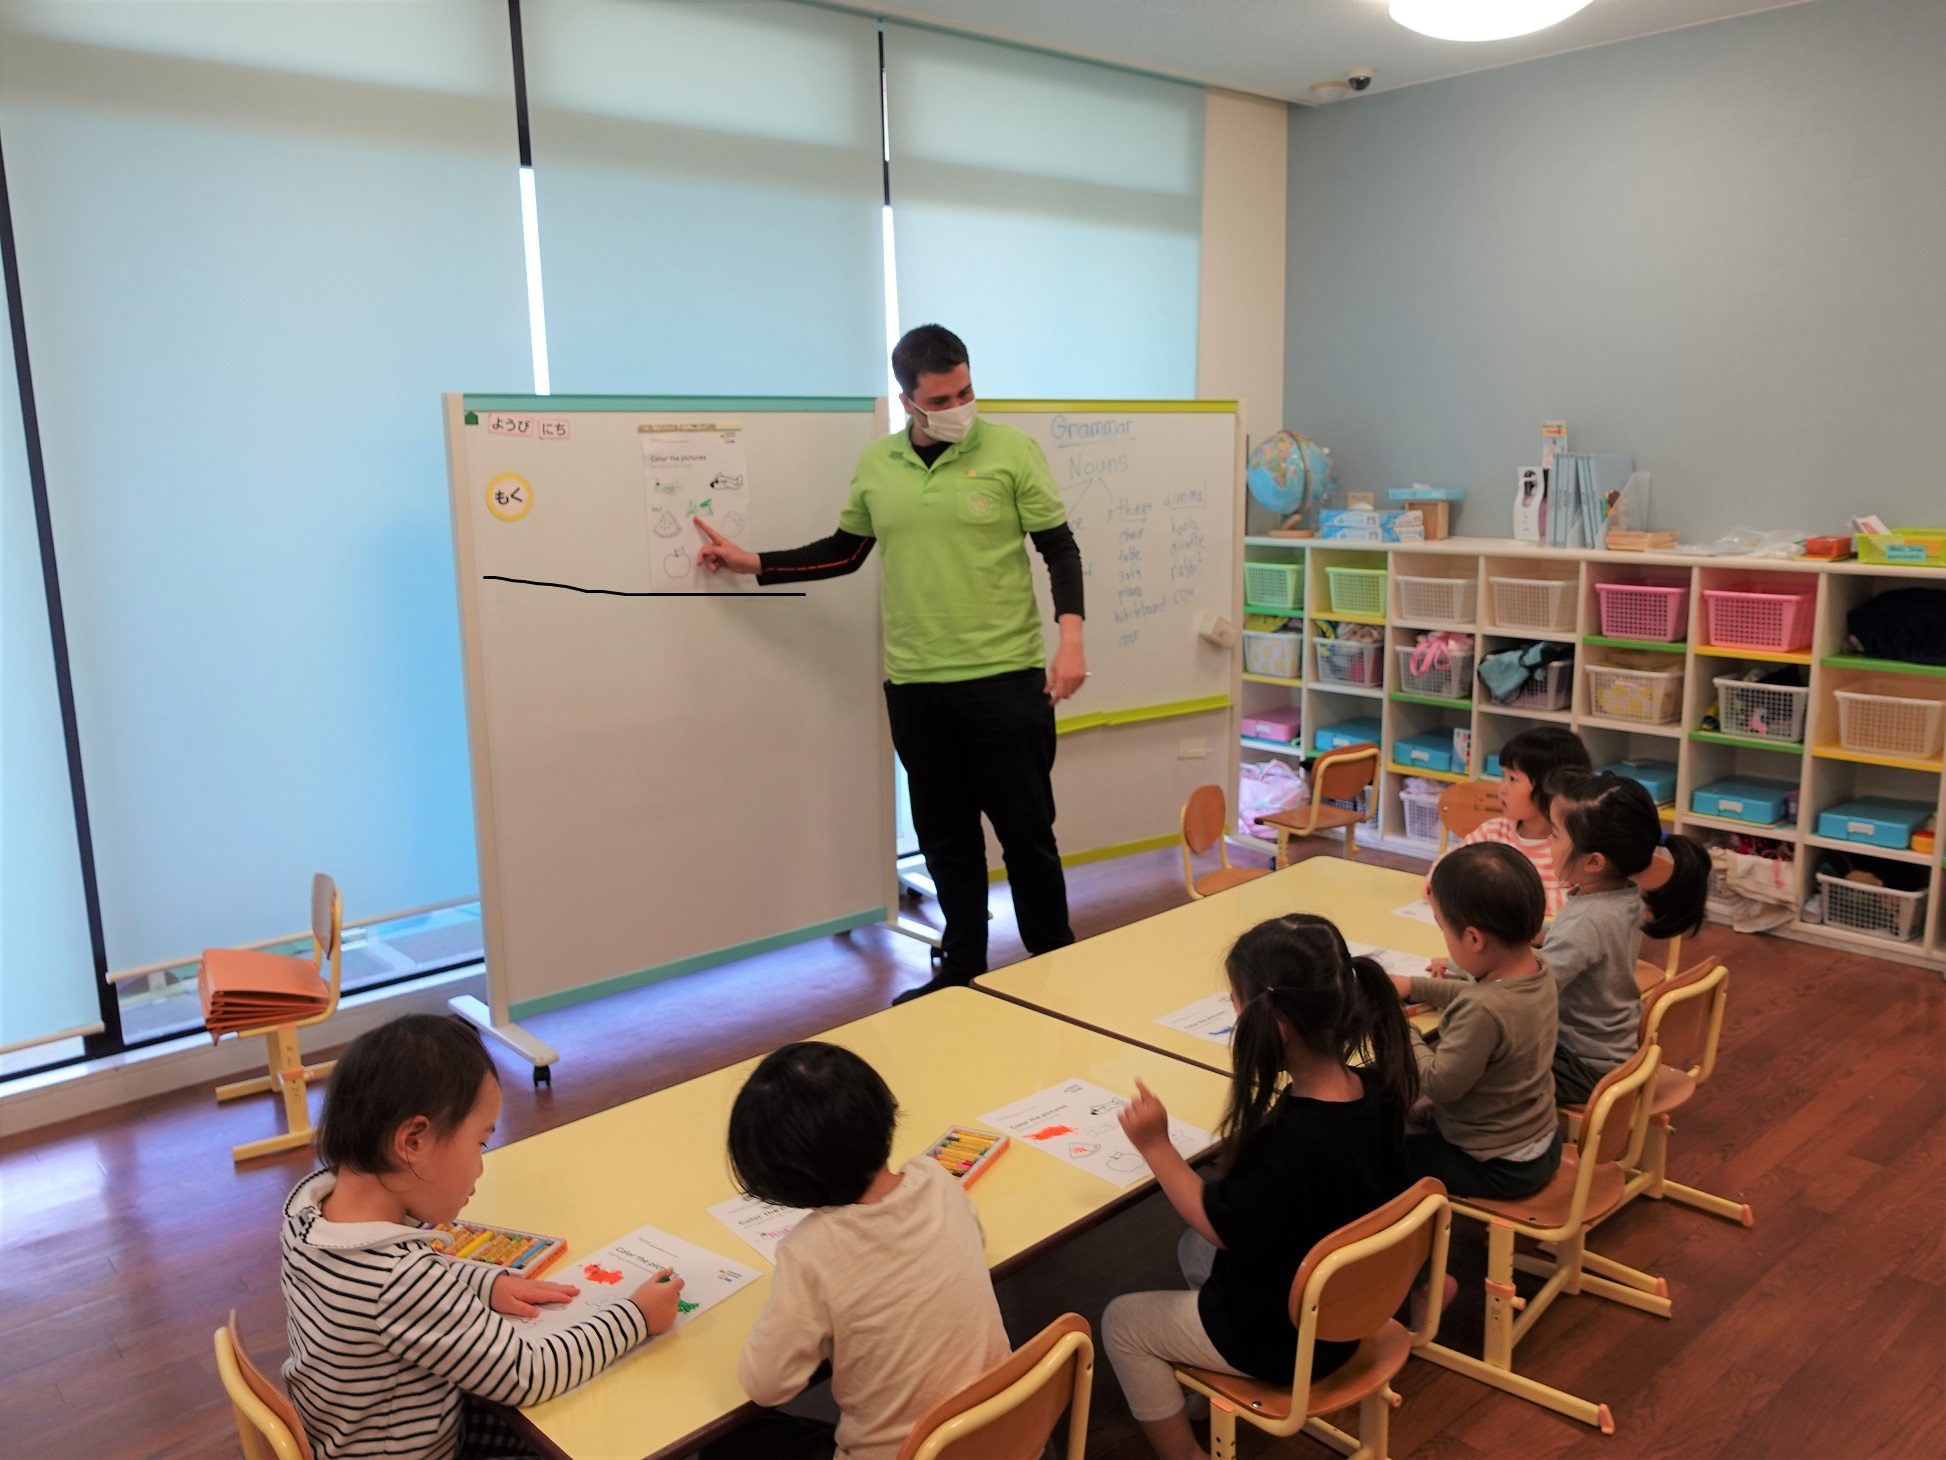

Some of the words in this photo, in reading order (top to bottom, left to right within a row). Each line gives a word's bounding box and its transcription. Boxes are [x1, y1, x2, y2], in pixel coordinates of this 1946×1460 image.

[492, 417, 530, 433] ようび
[542, 422, 566, 436] にち
[1051, 415, 1134, 439] Grammar
[1069, 453, 1129, 478] Nouns
[494, 487, 523, 505] もく
